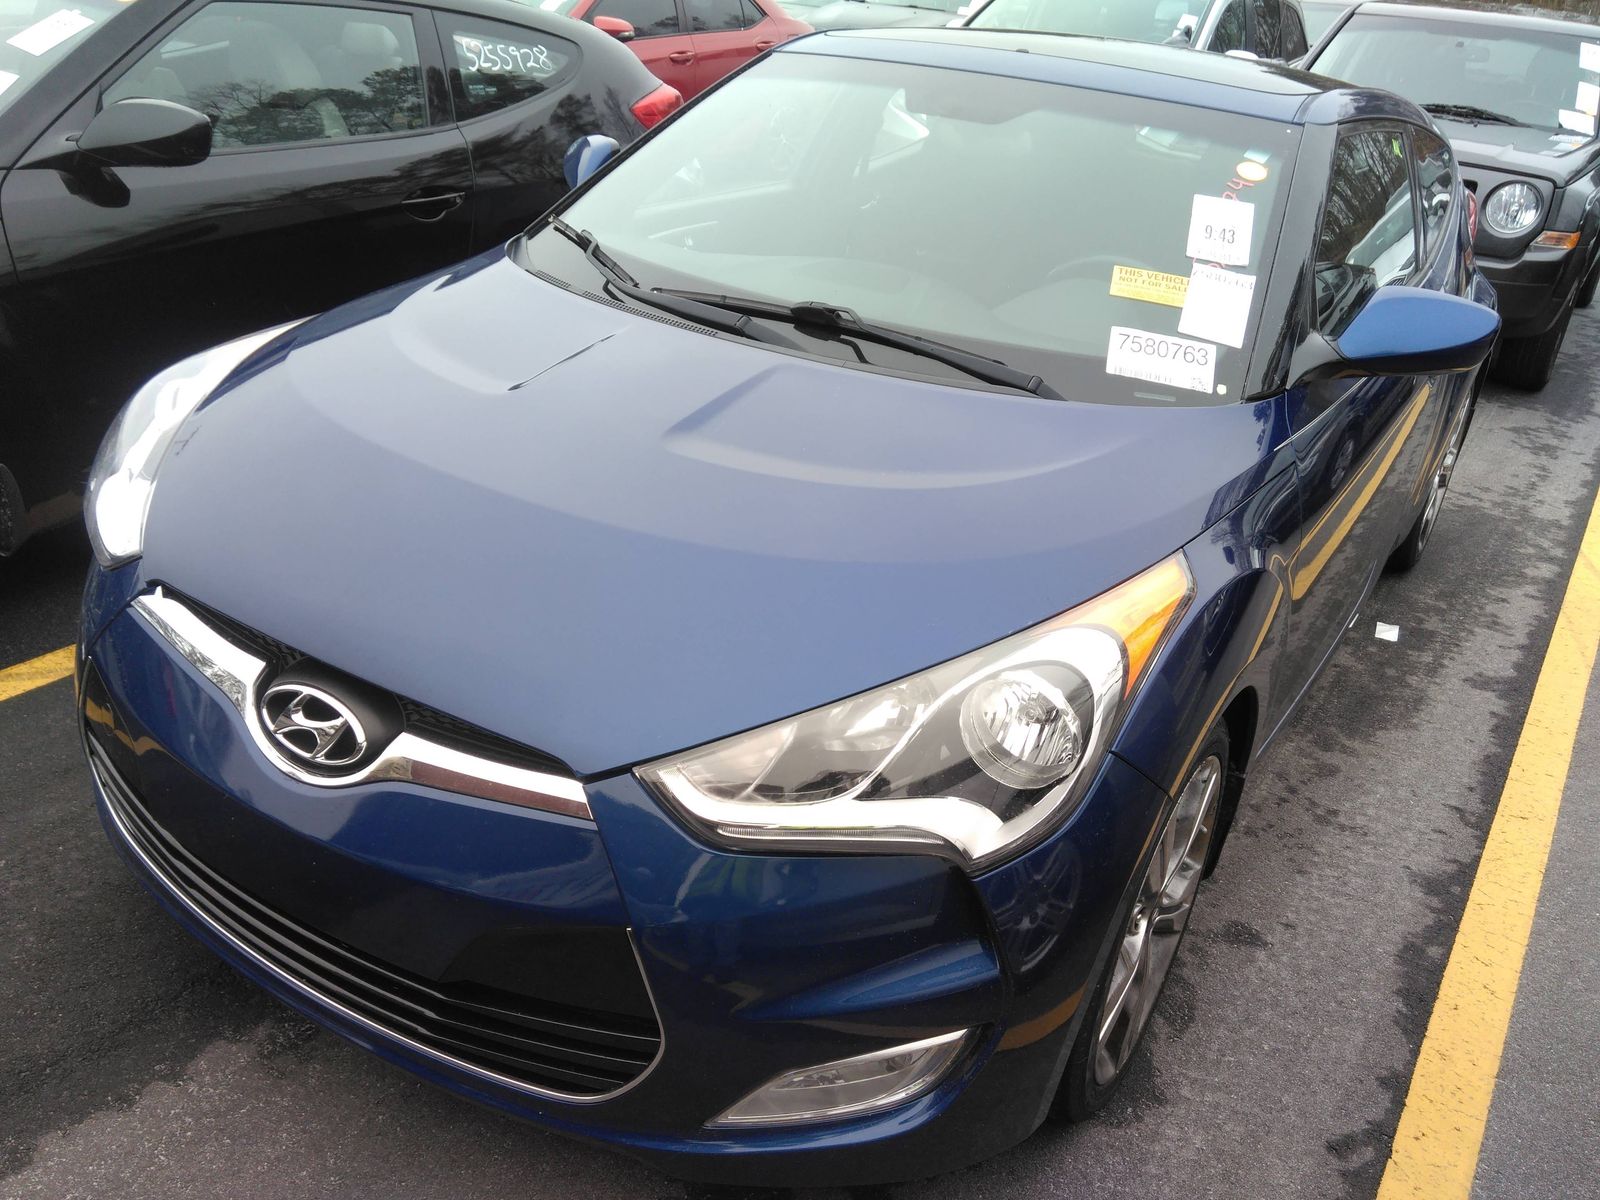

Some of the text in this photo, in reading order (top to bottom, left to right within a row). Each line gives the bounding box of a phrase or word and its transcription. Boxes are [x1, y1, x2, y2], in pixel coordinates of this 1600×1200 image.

[462, 39, 552, 73] 5255928
[1117, 267, 1143, 278] THIS
[1118, 275, 1138, 284] NOT
[1142, 279, 1161, 288] FOR
[1118, 332, 1209, 366] 7580763
